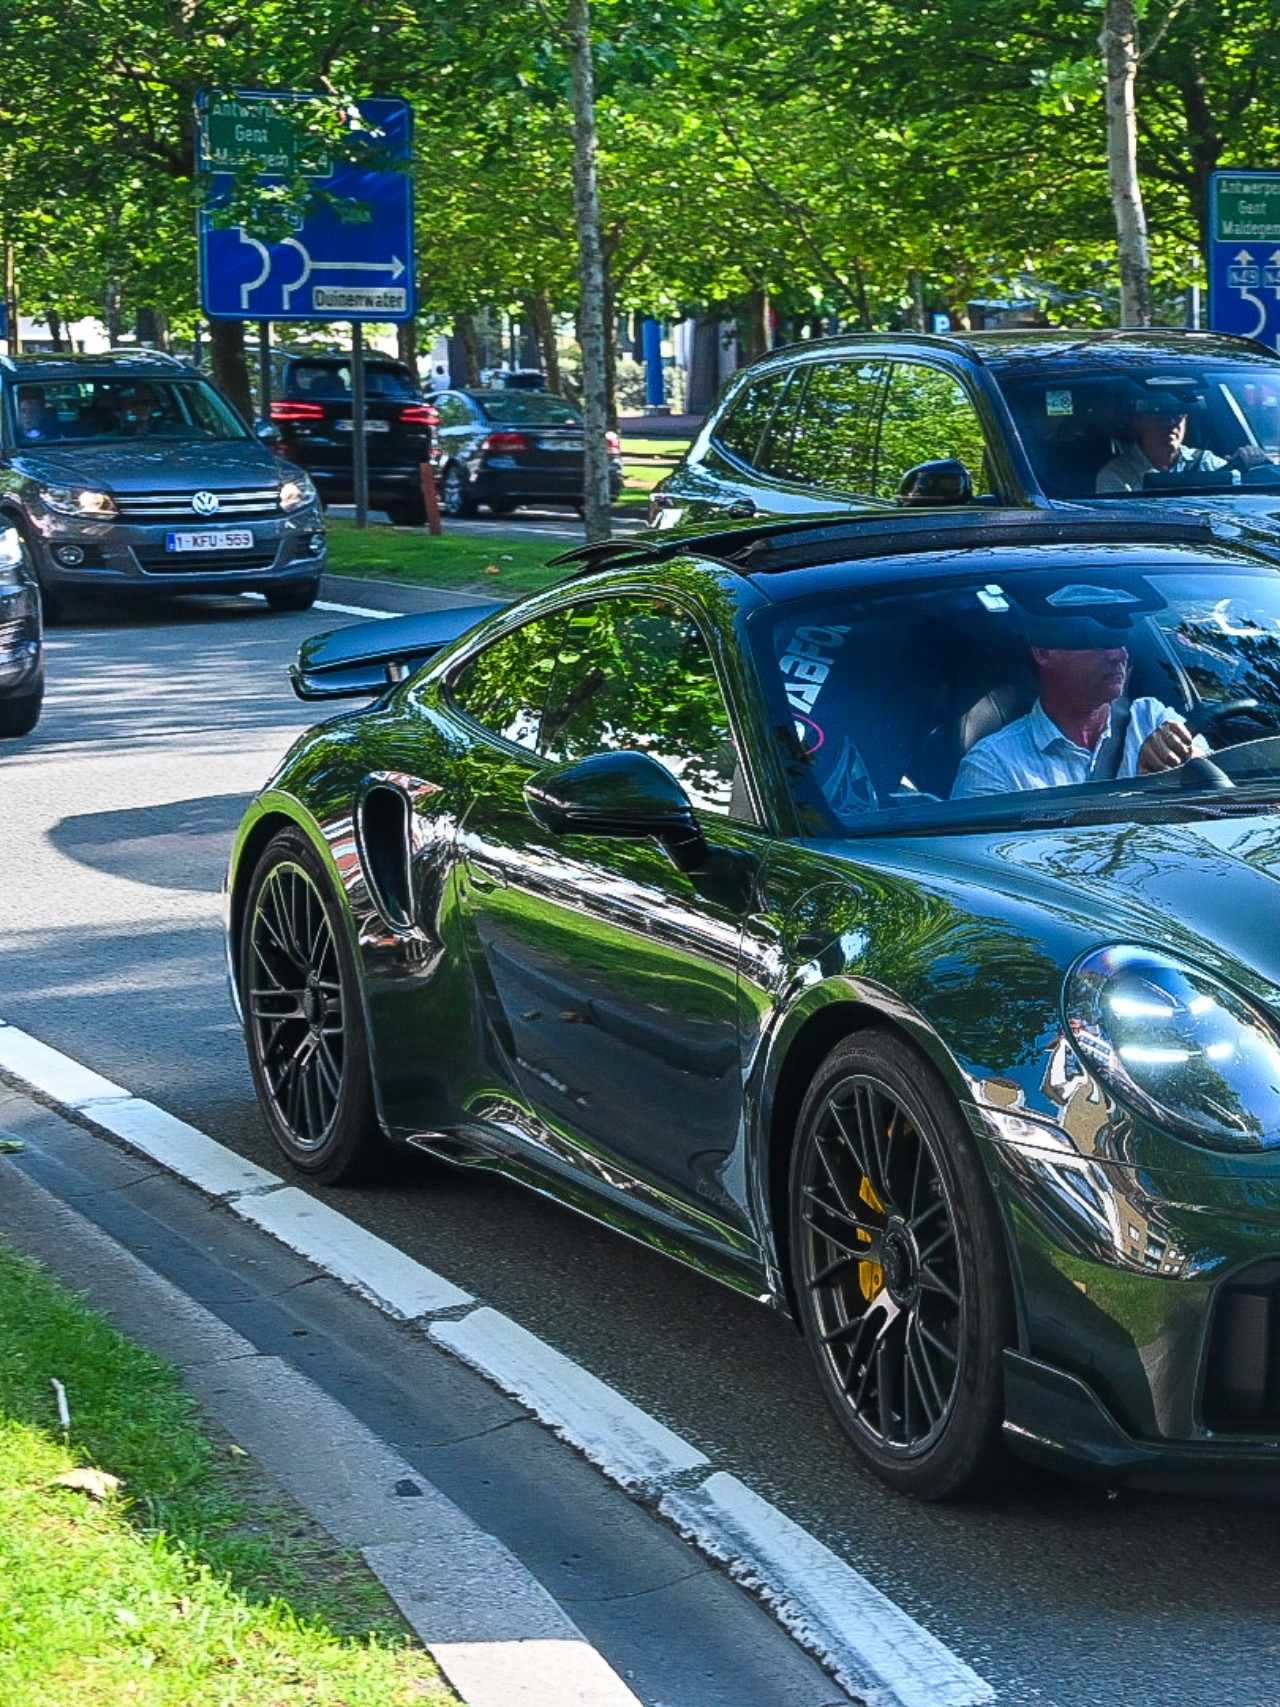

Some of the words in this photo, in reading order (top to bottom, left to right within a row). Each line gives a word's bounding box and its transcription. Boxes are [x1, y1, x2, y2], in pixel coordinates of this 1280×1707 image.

[235, 124, 268, 143] Gent
[1238, 200, 1266, 215] Gent
[316, 289, 404, 309] Duinenwater
[934, 315, 950, 334] P
